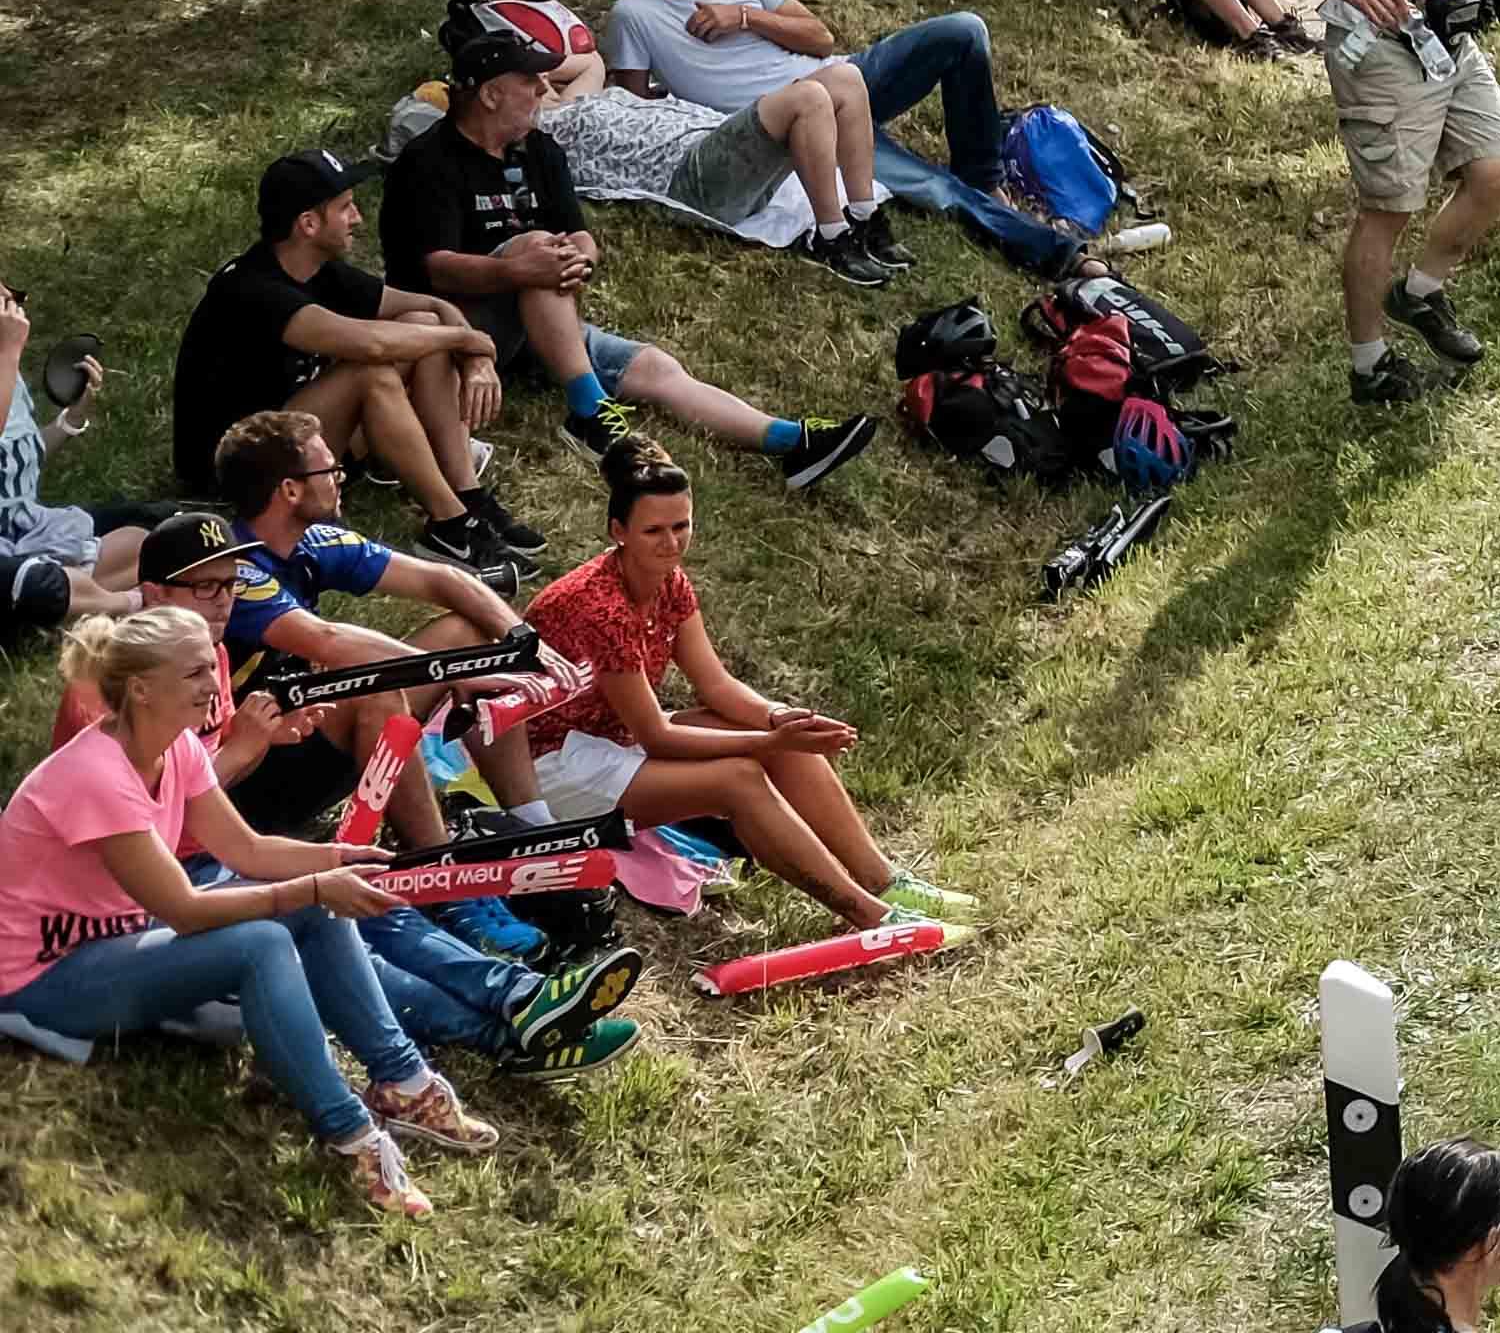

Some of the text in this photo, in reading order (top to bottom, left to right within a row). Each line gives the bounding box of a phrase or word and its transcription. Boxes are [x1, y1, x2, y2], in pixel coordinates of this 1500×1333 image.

[445, 651, 521, 677] SCOTT
[306, 673, 380, 700] SCOTT
[511, 836, 582, 859] SCOTT
[452, 866, 502, 892] new
